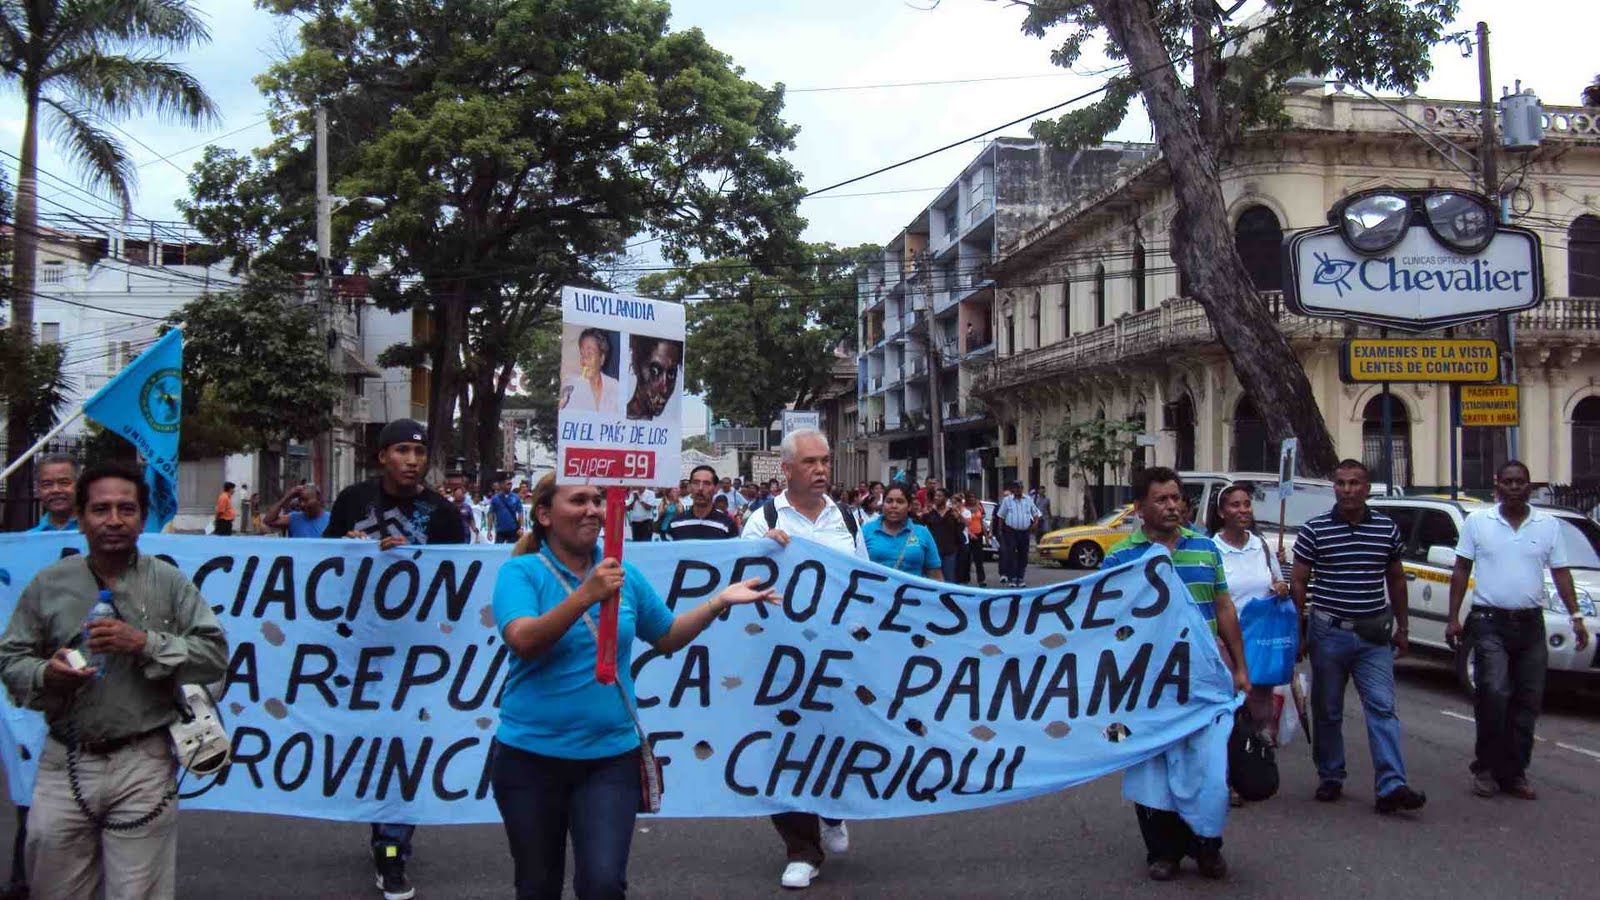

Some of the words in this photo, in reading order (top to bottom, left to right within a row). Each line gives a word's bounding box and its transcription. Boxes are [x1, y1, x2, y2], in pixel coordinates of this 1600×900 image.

[1359, 257, 1530, 293] Chevalier
[574, 292, 655, 321] LUCYLANDIA
[1354, 345, 1418, 359] EXAMENES
[1422, 345, 1437, 359] DE
[1441, 345, 1456, 359] LA
[1459, 345, 1493, 359] VISTA
[1360, 361, 1403, 375] LENTES
[1407, 361, 1422, 375] DE
[1426, 361, 1489, 375] CONTACTO
[561, 421, 579, 441] EN
[579, 421, 594, 442] EL
[629, 425, 645, 445] DE
[648, 427, 668, 446] LOS
[624, 453, 649, 478] 99
[666, 554, 1173, 635] PROFESORES
[754, 645, 854, 711] DE
[887, 626, 1191, 721] PANAMÁ
[724, 731, 1026, 803] CHIRIQUI
